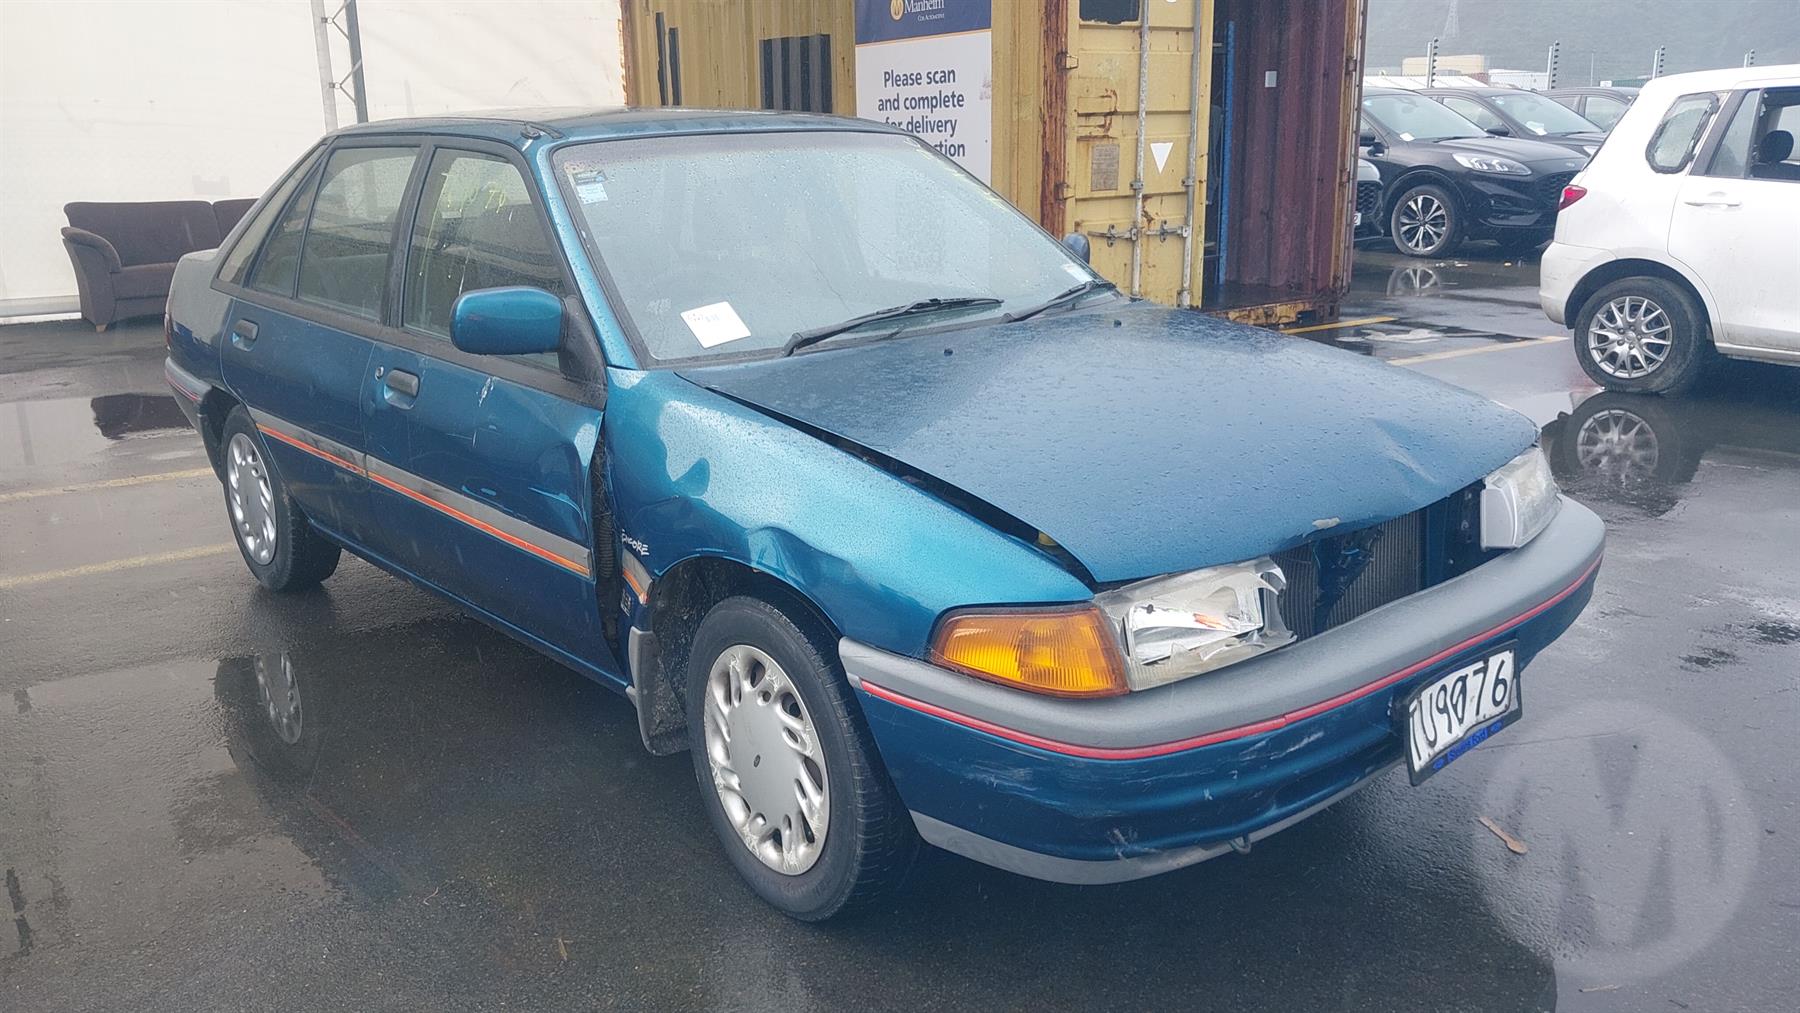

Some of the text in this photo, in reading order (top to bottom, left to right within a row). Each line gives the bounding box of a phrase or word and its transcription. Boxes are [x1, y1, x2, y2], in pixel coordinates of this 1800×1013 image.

[904, 0, 945, 13] Manheim
[883, 69, 956, 88] Please scan
[878, 90, 965, 113] and complete
[906, 115, 958, 137] delivery
